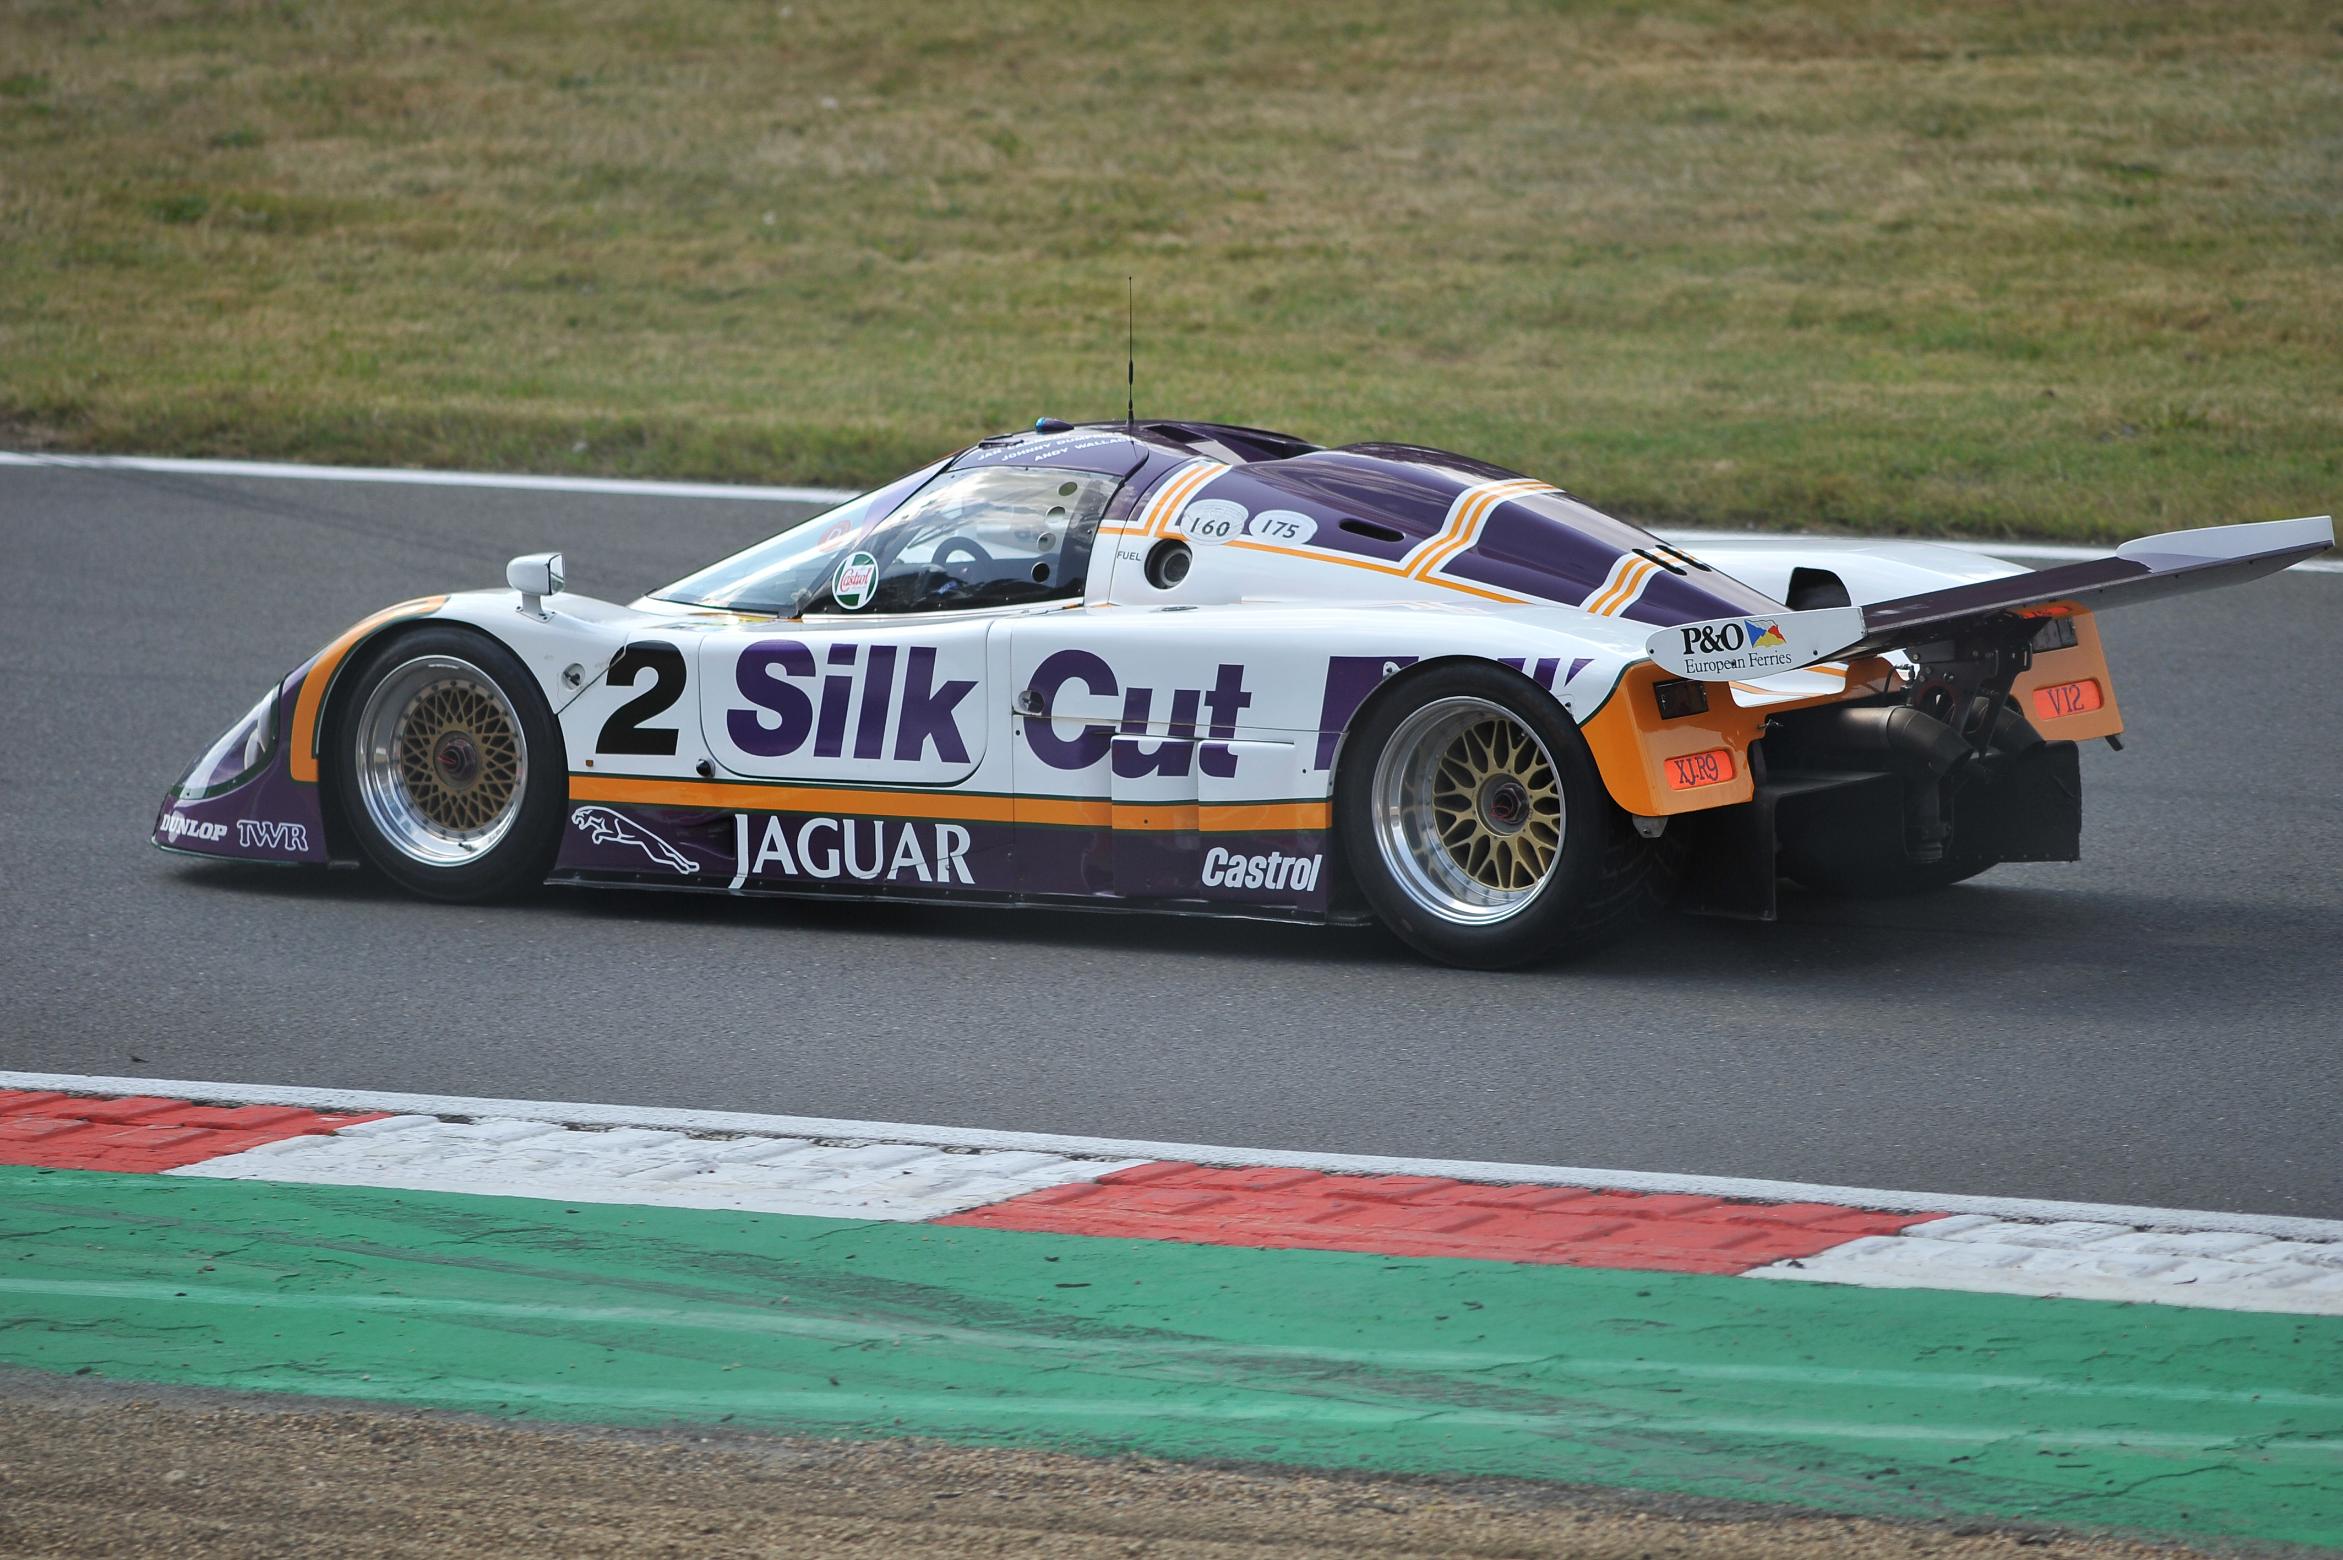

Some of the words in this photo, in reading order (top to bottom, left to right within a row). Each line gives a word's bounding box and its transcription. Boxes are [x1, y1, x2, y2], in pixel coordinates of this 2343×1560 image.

[978, 448, 1002, 461] JAN
[1001, 443, 1051, 462] JOHNNY
[1034, 447, 1068, 462] ANDY
[1190, 517, 1230, 538] 160
[1261, 519, 1300, 539] 175
[1116, 551, 1141, 562] FUEL
[840, 567, 873, 593] Castrol
[1680, 623, 1745, 655] P&O
[1685, 656, 1746, 674] European
[1749, 650, 1792, 668] Ferries
[595, 640, 688, 756] 2
[726, 639, 978, 764] Silk
[1023, 649, 1252, 779] Cut
[2047, 685, 2085, 718] V12
[160, 813, 228, 842] DUNLOP
[237, 820, 309, 851] TWR
[728, 813, 976, 890] JAGUAR
[1201, 846, 1323, 892] Castrol
